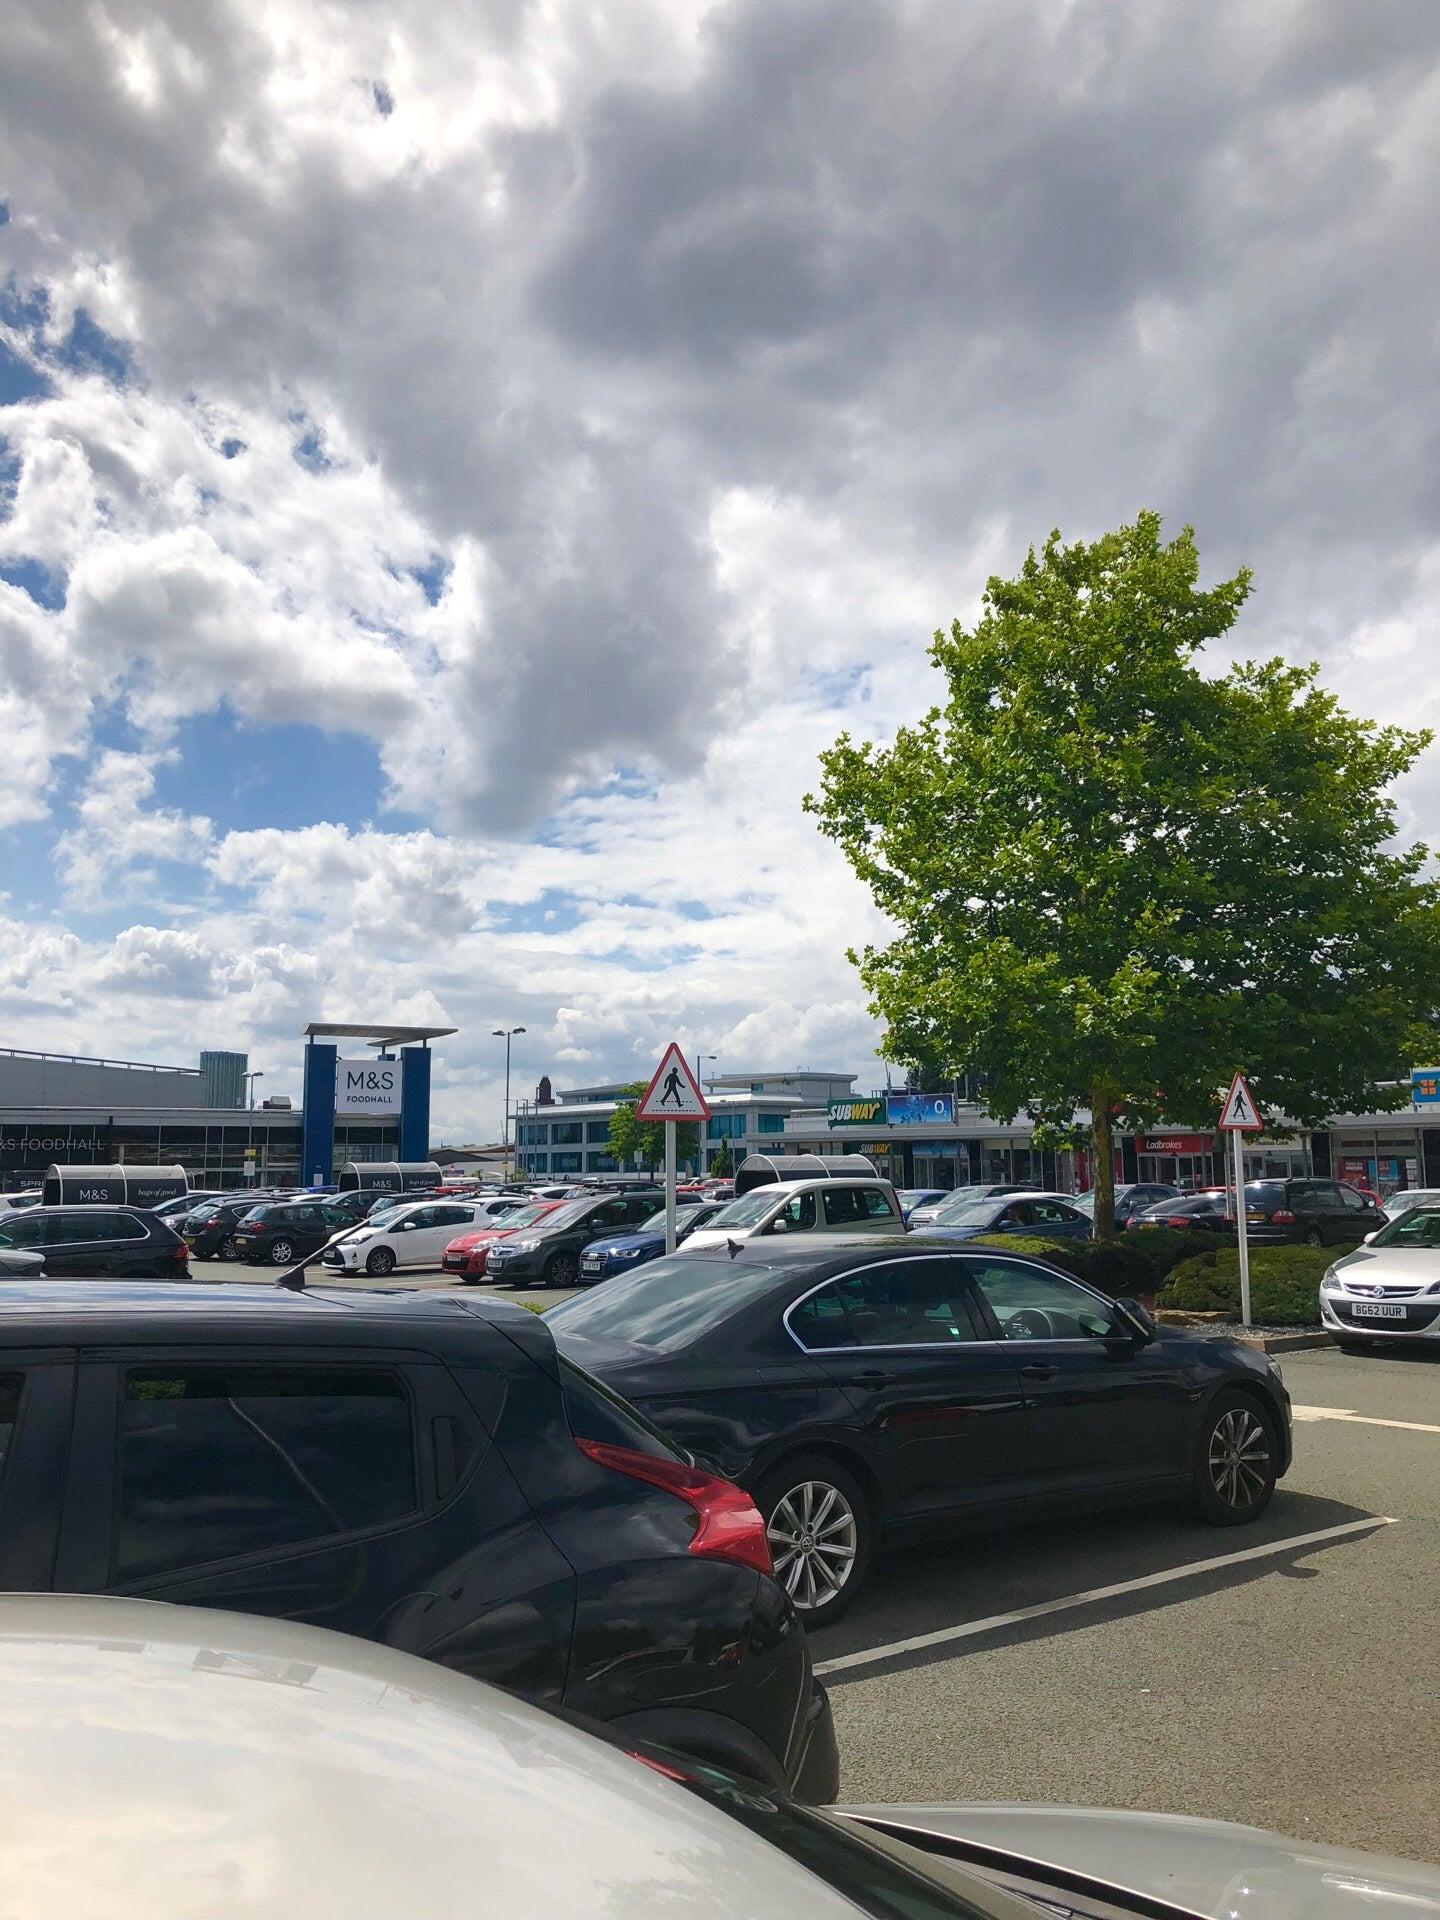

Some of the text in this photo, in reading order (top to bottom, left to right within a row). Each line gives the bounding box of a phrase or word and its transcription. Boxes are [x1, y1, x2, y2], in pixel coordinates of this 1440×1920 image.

[347, 1071, 394, 1090] M&S
[346, 1095, 393, 1103] FOODHALL
[828, 1103, 880, 1120] SUBWAY
[20, 1138, 105, 1151] FOODHALL
[859, 1143, 890, 1154] SUBWAY
[1146, 1140, 1183, 1150] Ladbrokes
[372, 1180, 392, 1189] M&S
[80, 1189, 109, 1200] M&S
[1356, 1305, 1402, 1317] BG62 UUR
